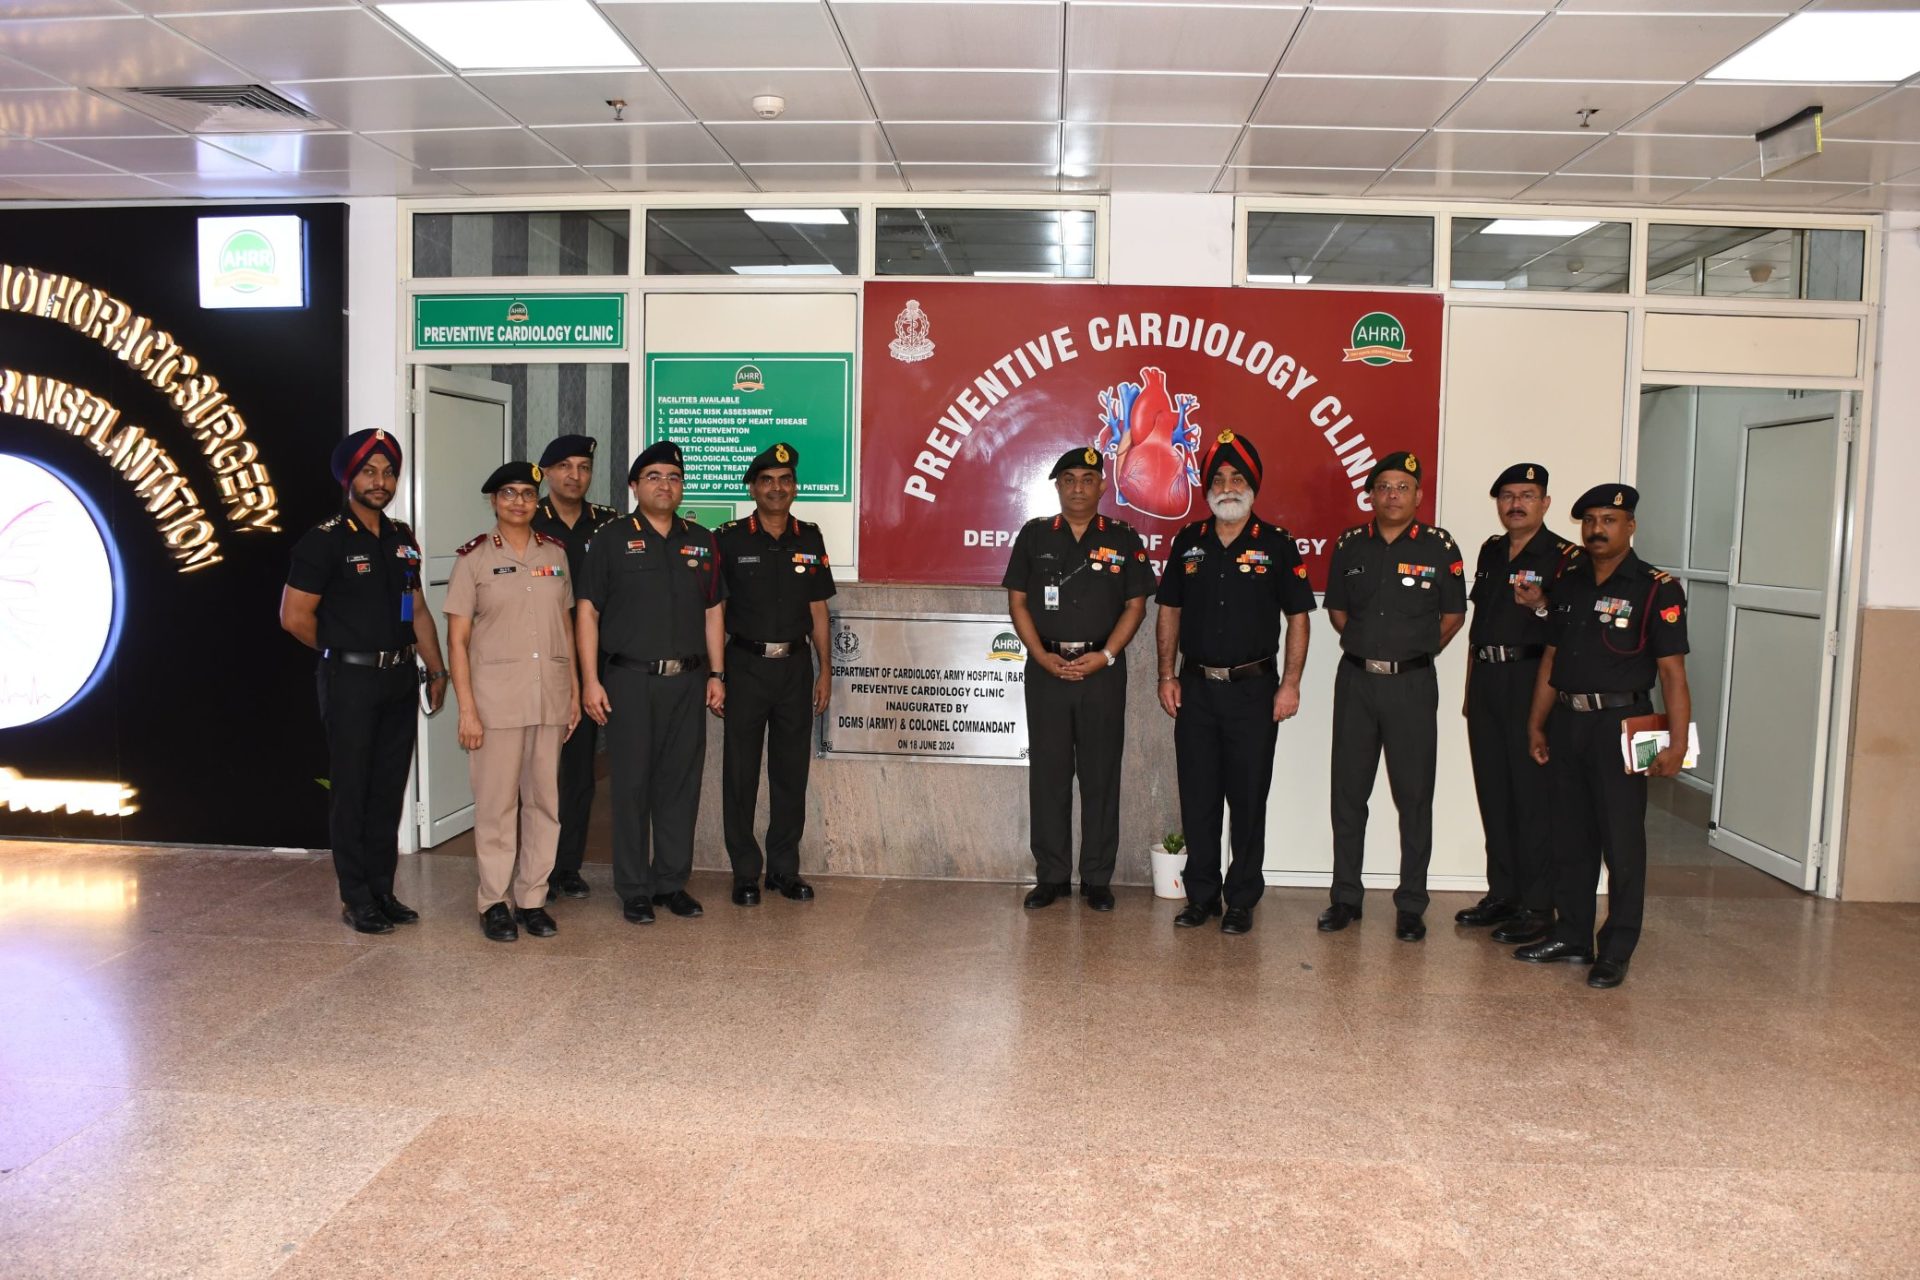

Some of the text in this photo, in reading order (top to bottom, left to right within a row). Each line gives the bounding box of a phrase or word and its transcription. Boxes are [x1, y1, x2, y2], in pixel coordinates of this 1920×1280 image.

[224, 249, 271, 266] AHRR
[424, 325, 614, 342] PREVENTIVE CARDIOLOGY CLINIC
[1356, 326, 1400, 342] AHRR
[739, 372, 760, 380] AHRR
[0, 264, 281, 532] IOTHORACIC SURGERY
[658, 396, 740, 404] FACILITIES AVAILABLE
[904, 326, 1079, 502] PREVENTIVE
[1087, 312, 1318, 400] CARDIOLOGY
[0, 369, 223, 573] RANSPLANTATION
[993, 639, 1020, 650] AHRR
[831, 666, 880, 678] DEPARTMENT
[881, 667, 892, 679] OF
[893, 668, 942, 681] CARDIOLOGY,
[943, 669, 965, 681] ARMY
[967, 670, 1003, 682] HOSPITAL
[851, 683, 1005, 698] PREVENTIVE CARDIOLOGY CLINIC
[886, 701, 969, 713] INAUGURATED BY
[838, 716, 1016, 734] DGMS (ARMY) & COLONEL COMMANDANT
[897, 739, 955, 751] ON 18 JUNE 2024
